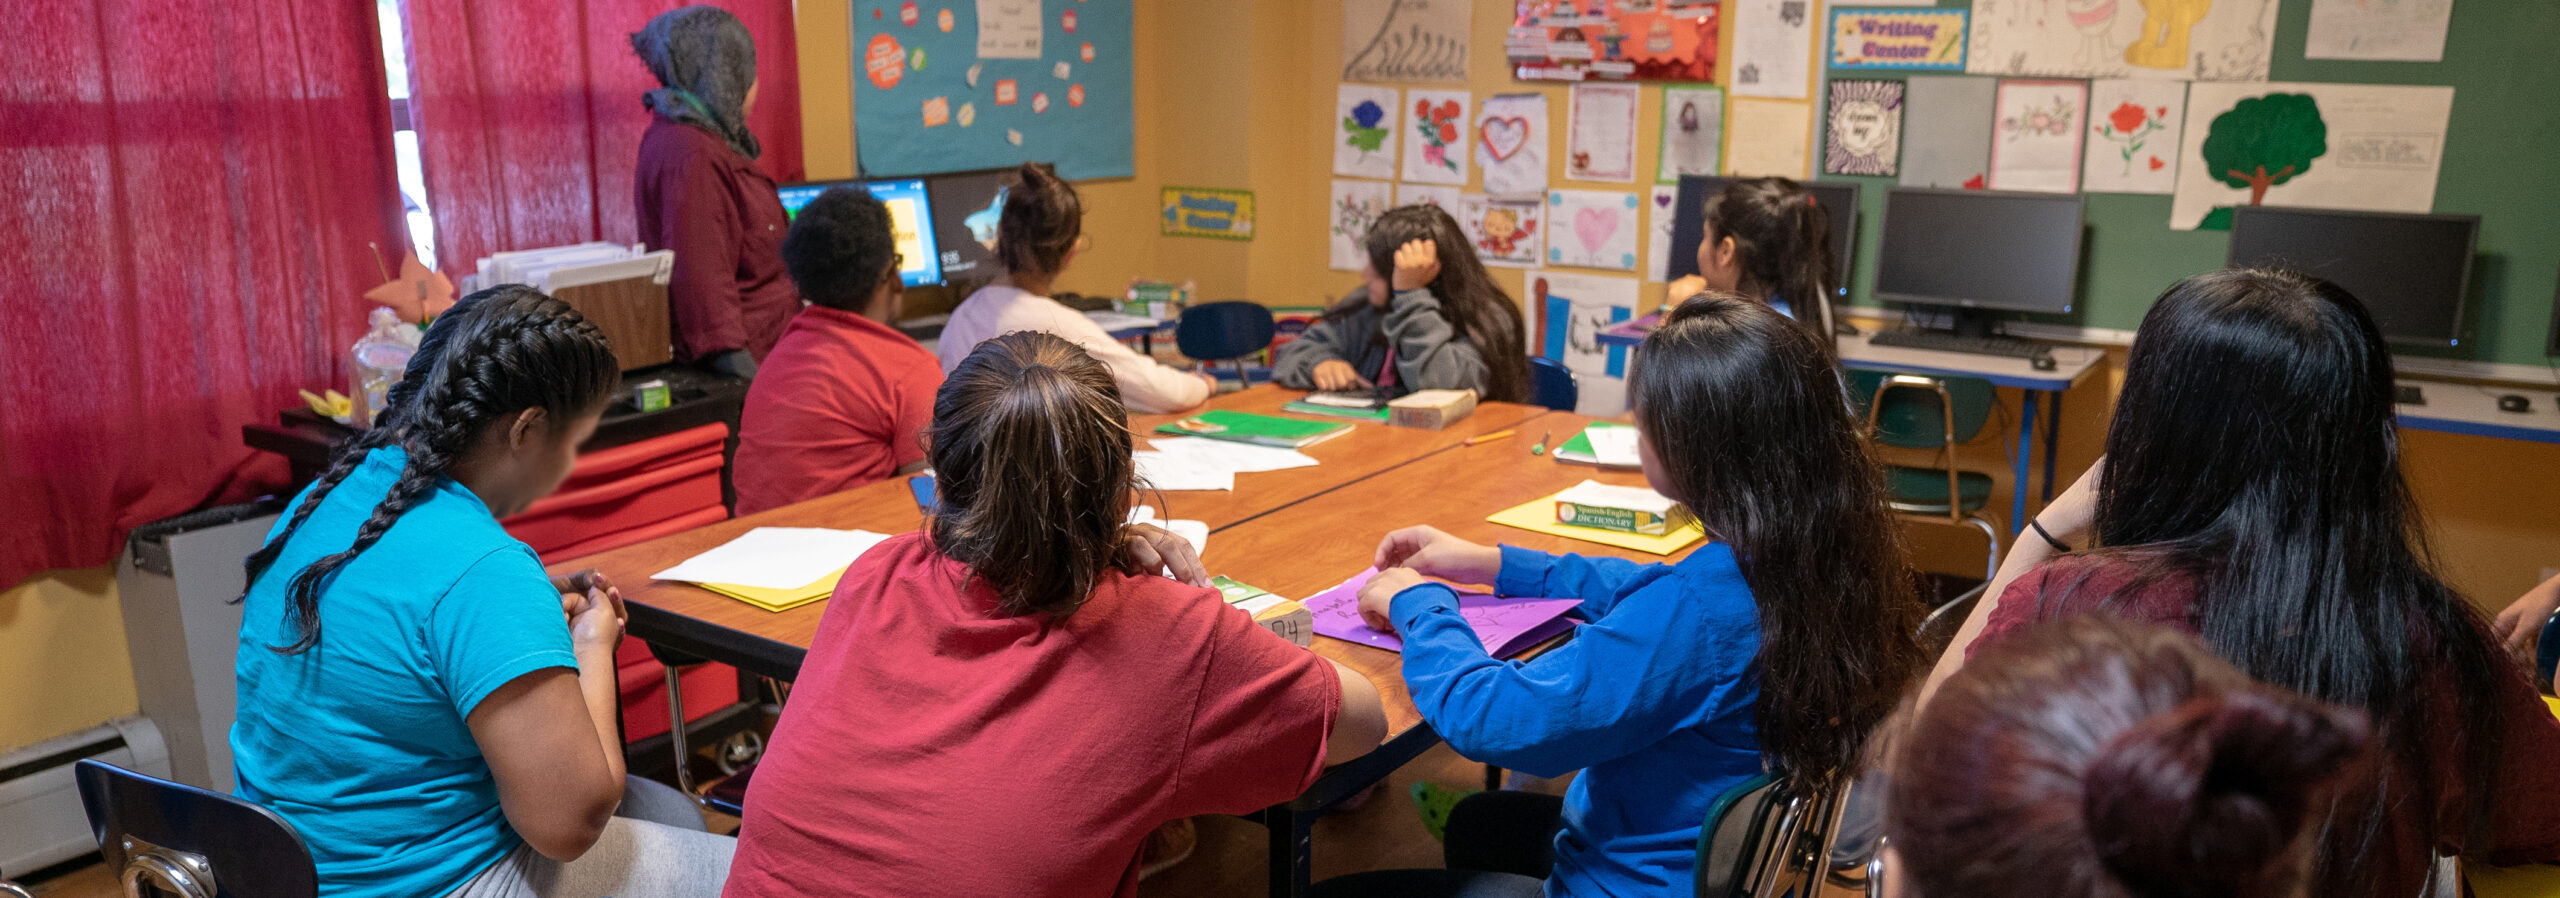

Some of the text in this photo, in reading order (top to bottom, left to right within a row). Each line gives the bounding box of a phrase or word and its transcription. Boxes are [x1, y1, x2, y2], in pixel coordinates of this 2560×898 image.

[1858, 19, 1939, 41] Writing
[1862, 42, 1931, 58] Center
[1577, 504, 1633, 519] Spanish-English
[1577, 514, 1632, 528] DICTIONARY
